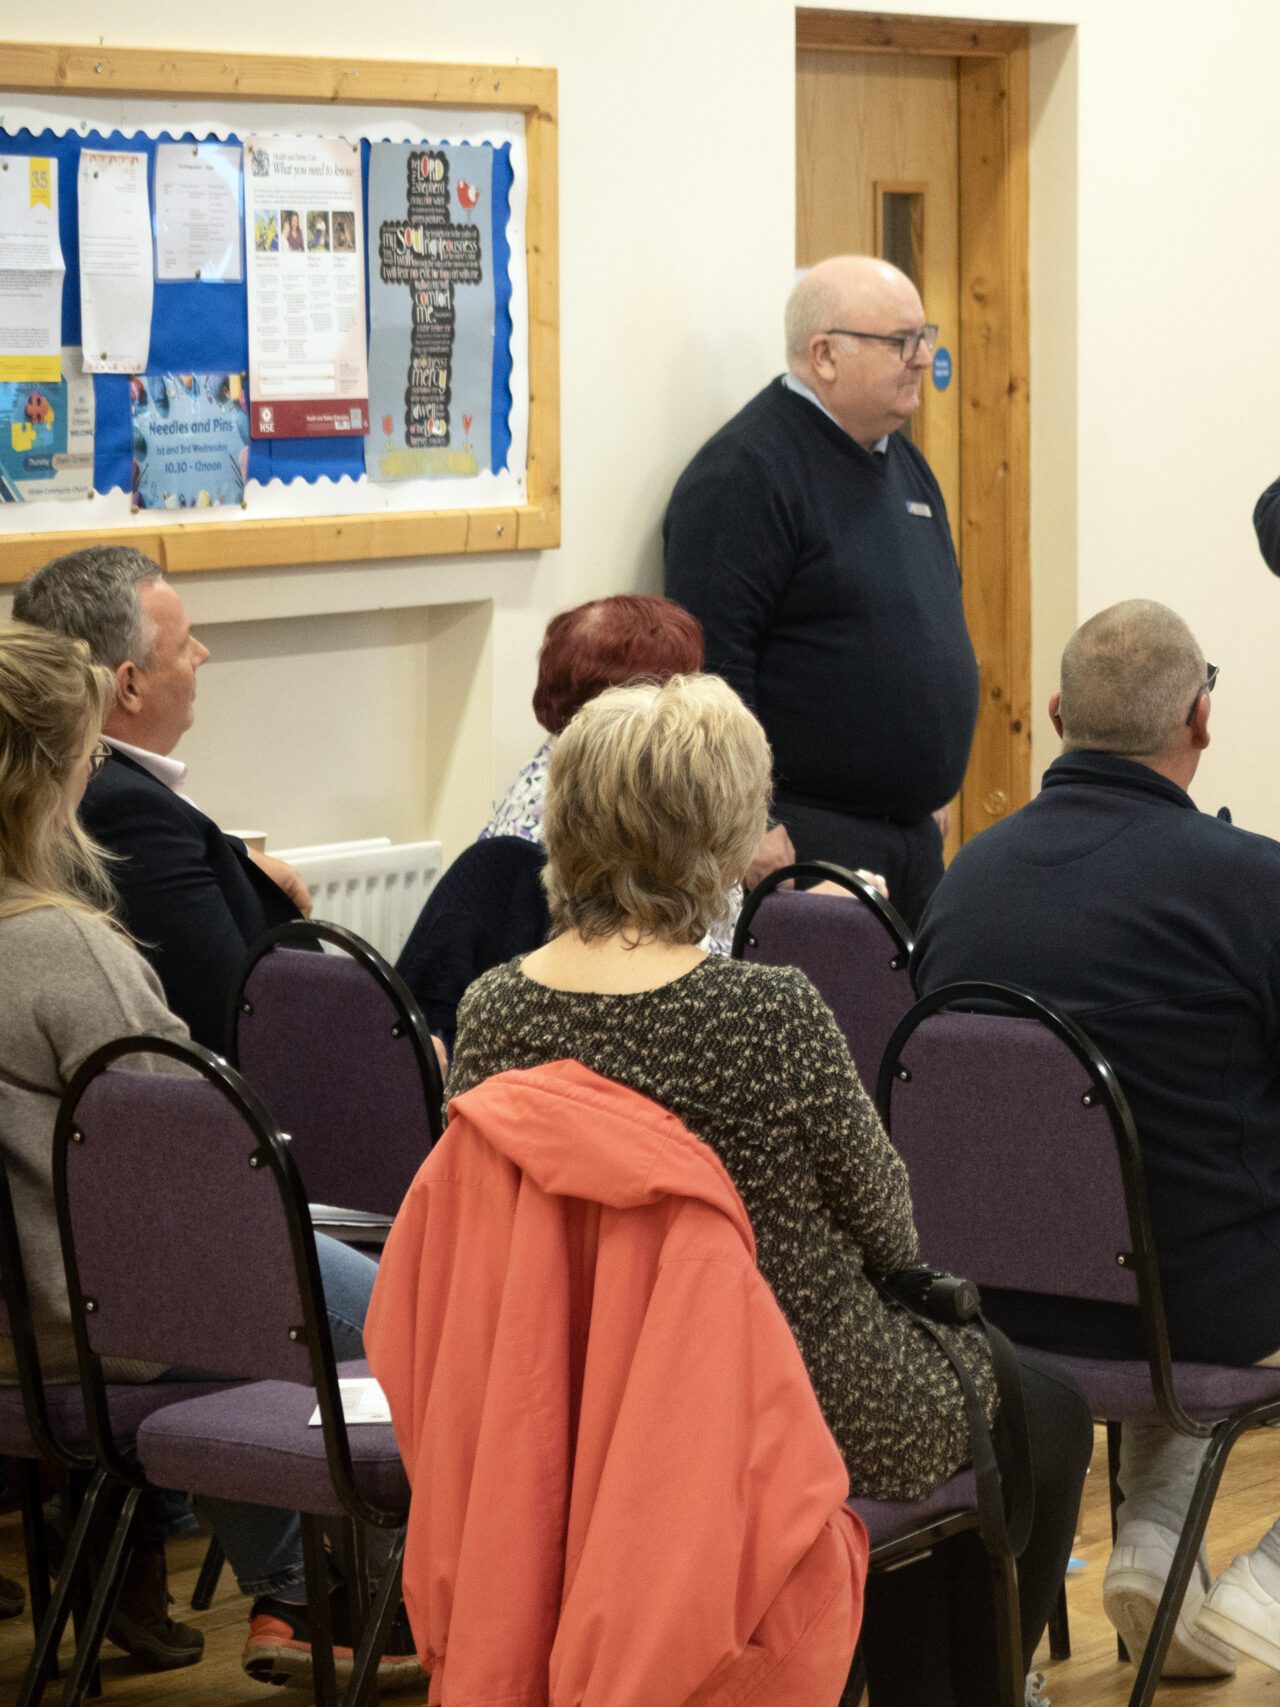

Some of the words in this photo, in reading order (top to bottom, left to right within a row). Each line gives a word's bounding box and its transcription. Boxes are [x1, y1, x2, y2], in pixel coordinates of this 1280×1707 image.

[417, 155, 444, 181] LORD
[412, 368, 447, 394] mercy
[149, 421, 188, 435] Needles
[191, 420, 210, 433] and
[214, 418, 233, 432] Pins
[260, 423, 275, 432] HSE
[167, 446, 179, 455] and
[193, 443, 228, 454] Wednesday
[165, 463, 187, 473] 10.30
